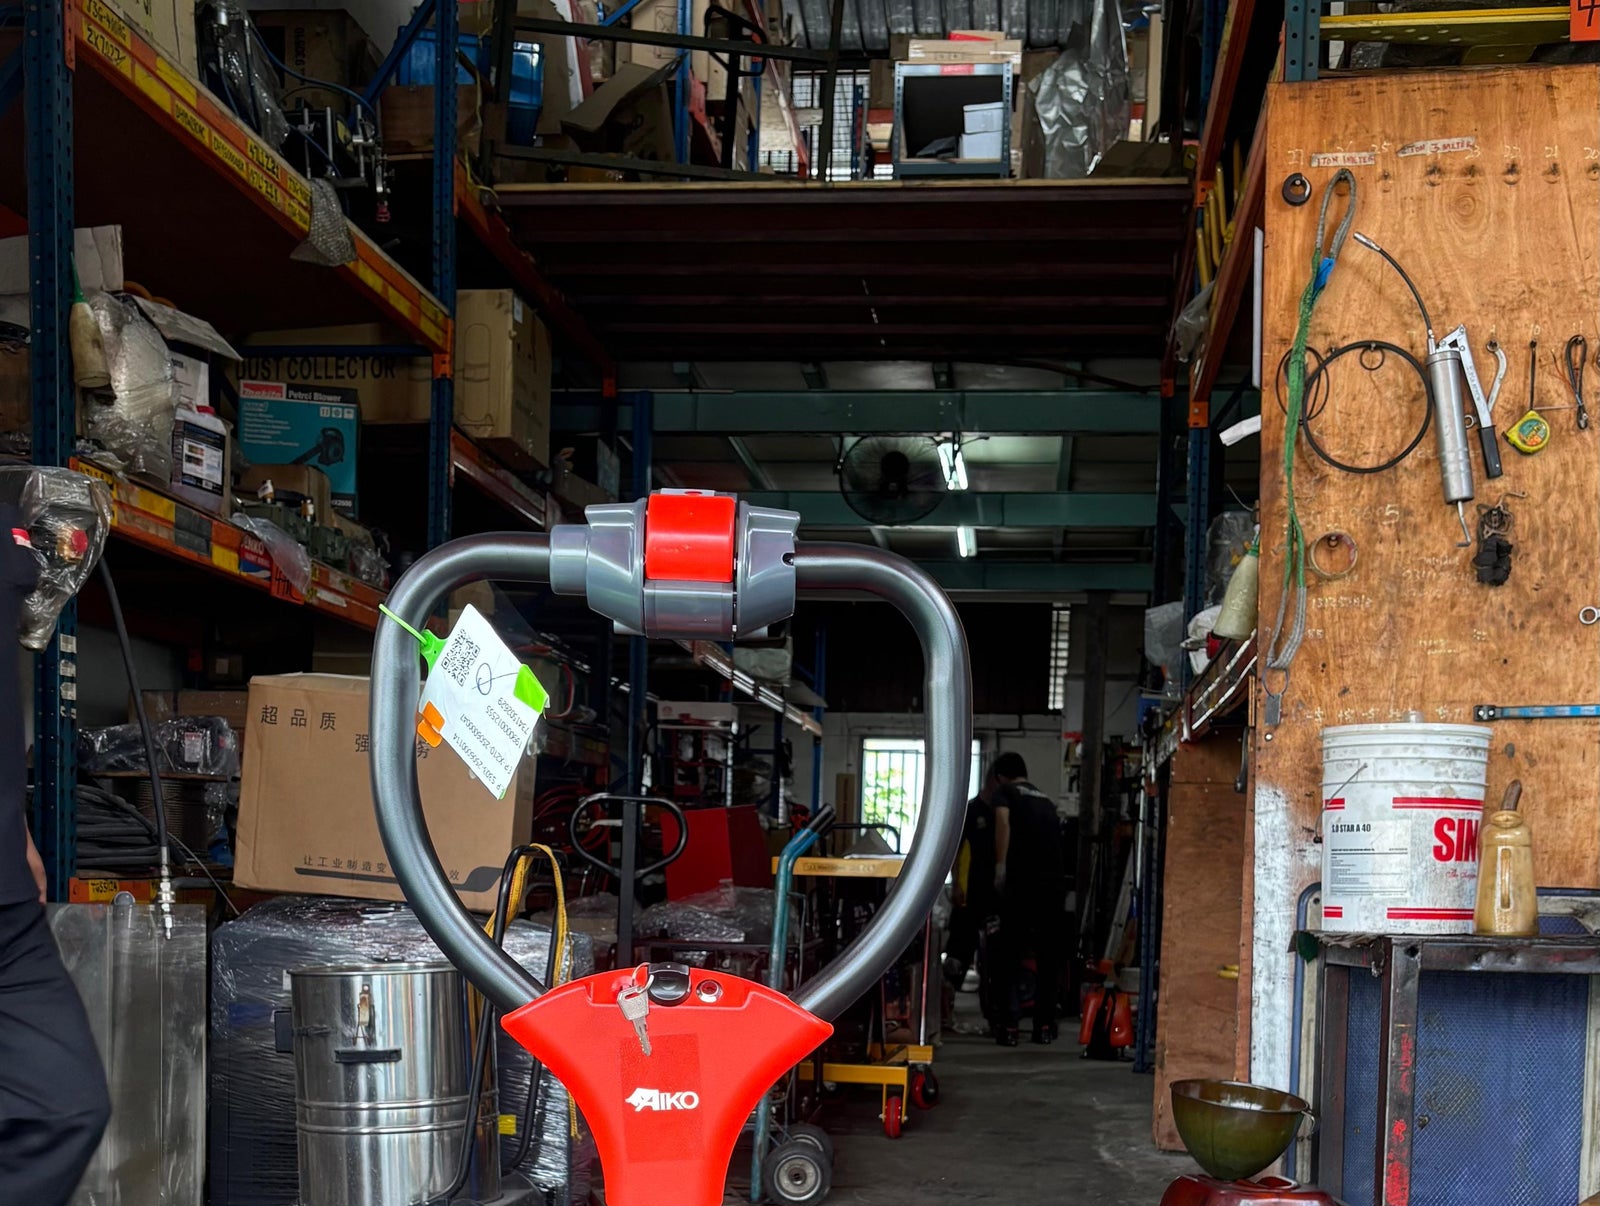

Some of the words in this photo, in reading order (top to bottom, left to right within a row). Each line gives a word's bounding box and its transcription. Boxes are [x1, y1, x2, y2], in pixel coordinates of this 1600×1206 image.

[236, 357, 282, 381] DUST
[286, 355, 396, 380] COLLECTOR
[1340, 824, 1355, 833] STAR
[1362, 823, 1372, 833] 40
[625, 1087, 700, 1112] AIKO
